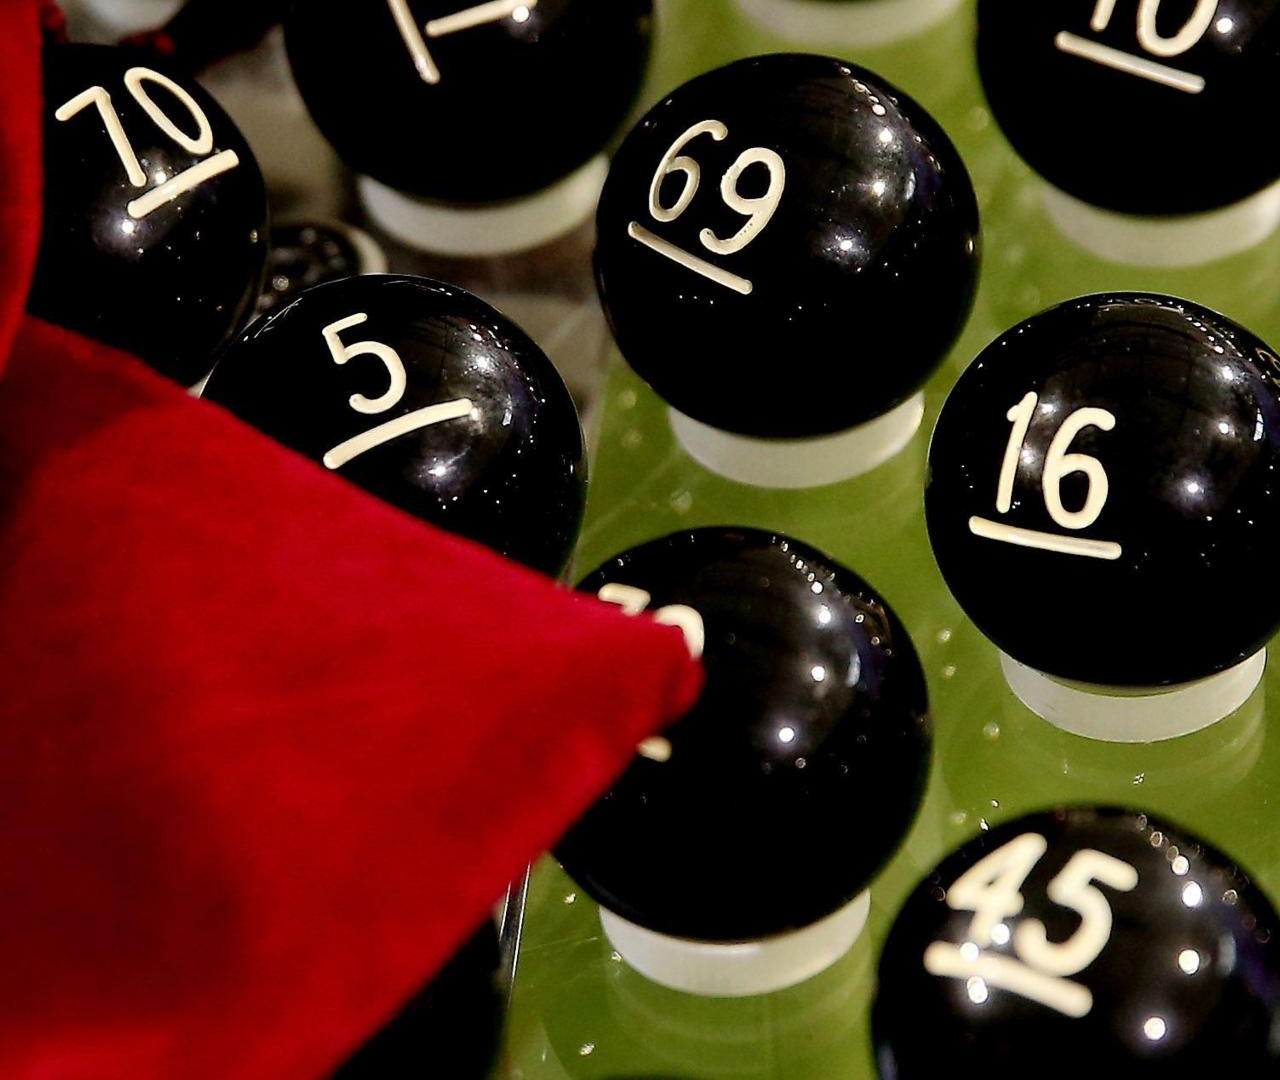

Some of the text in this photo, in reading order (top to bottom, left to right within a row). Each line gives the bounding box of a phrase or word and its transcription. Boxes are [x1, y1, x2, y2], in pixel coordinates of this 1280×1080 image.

[54, 66, 214, 188] 70
[648, 119, 786, 256] 69
[321, 312, 407, 415] 5
[996, 391, 1116, 530] 16
[946, 832, 1139, 977] 45
